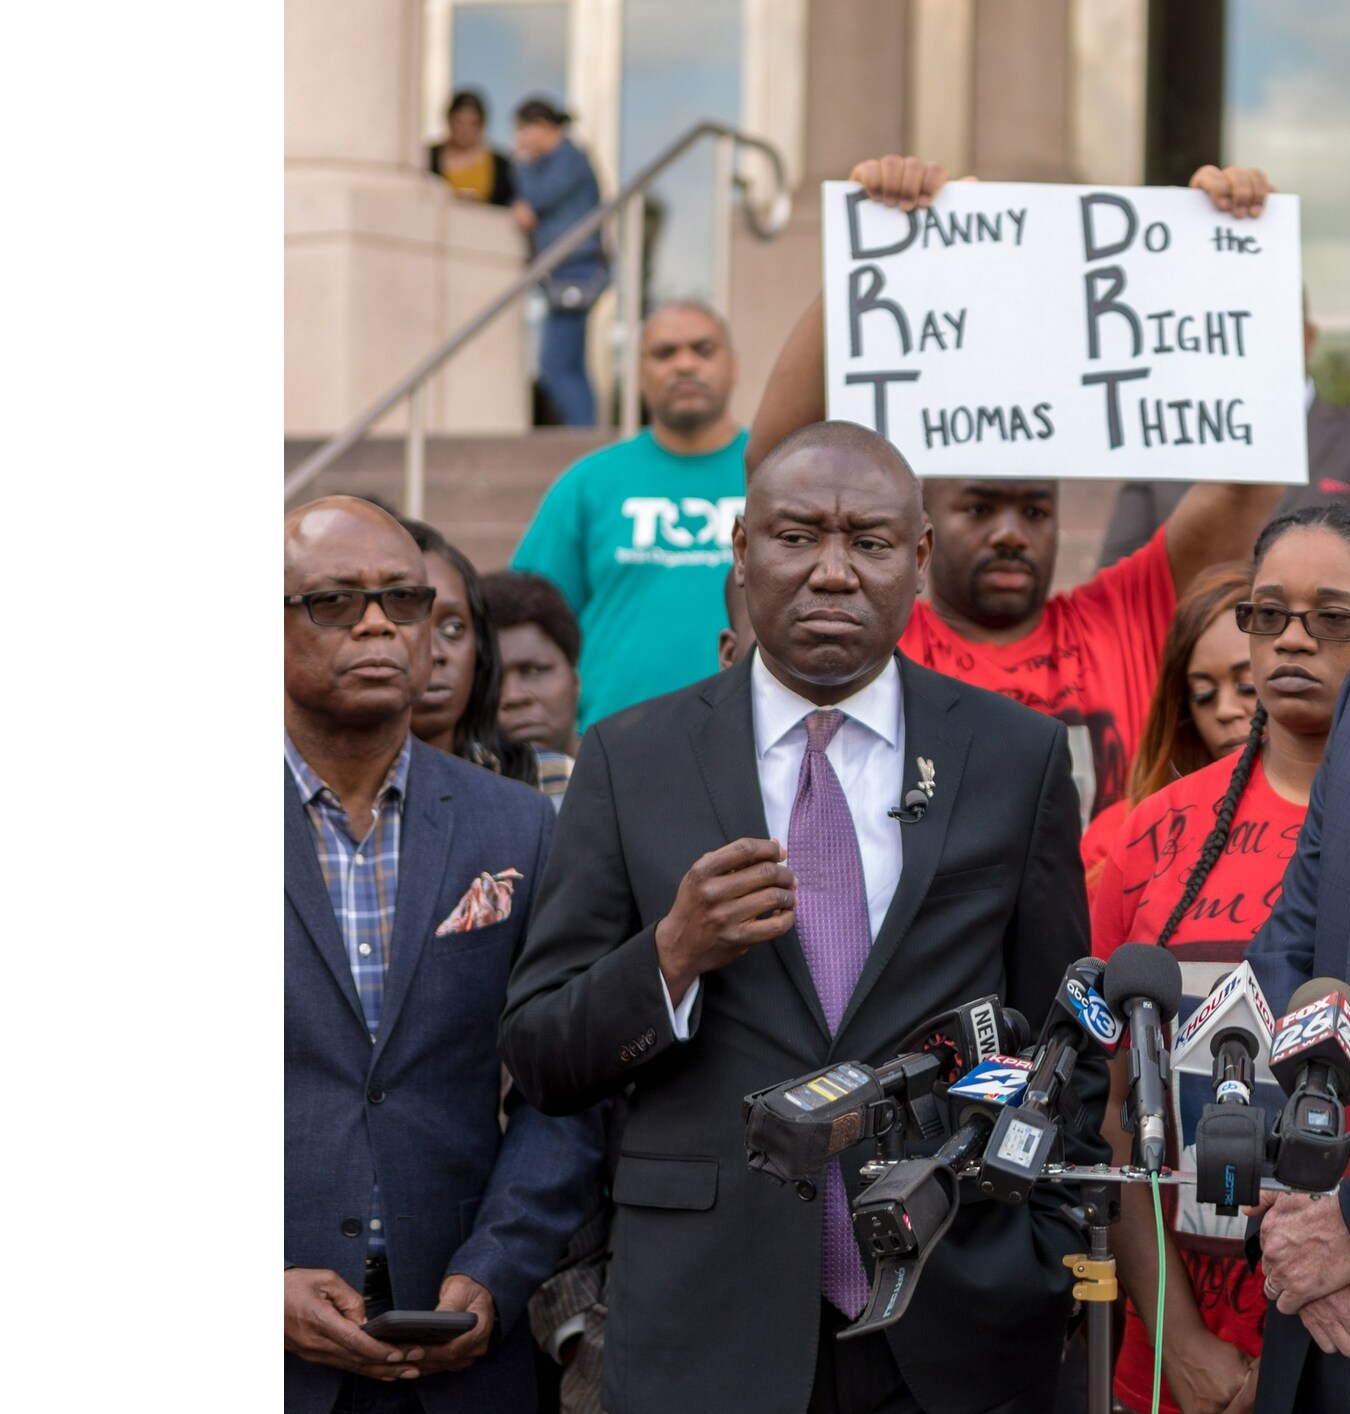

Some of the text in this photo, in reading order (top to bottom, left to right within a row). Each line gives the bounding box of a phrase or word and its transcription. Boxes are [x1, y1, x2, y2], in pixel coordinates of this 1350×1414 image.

[846, 188, 1028, 260] DANNY
[1210, 226, 1263, 254] the
[848, 264, 968, 358] RAY
[1083, 265, 1252, 359] RIGHT
[845, 369, 1056, 449] THOMAS
[1081, 367, 1254, 450] THING
[1066, 982, 1091, 1009] abc
[1088, 1001, 1117, 1038] 13
[1281, 994, 1331, 1029] FOX
[974, 1010, 998, 1059] NEW
[1272, 1007, 1333, 1056] 26
